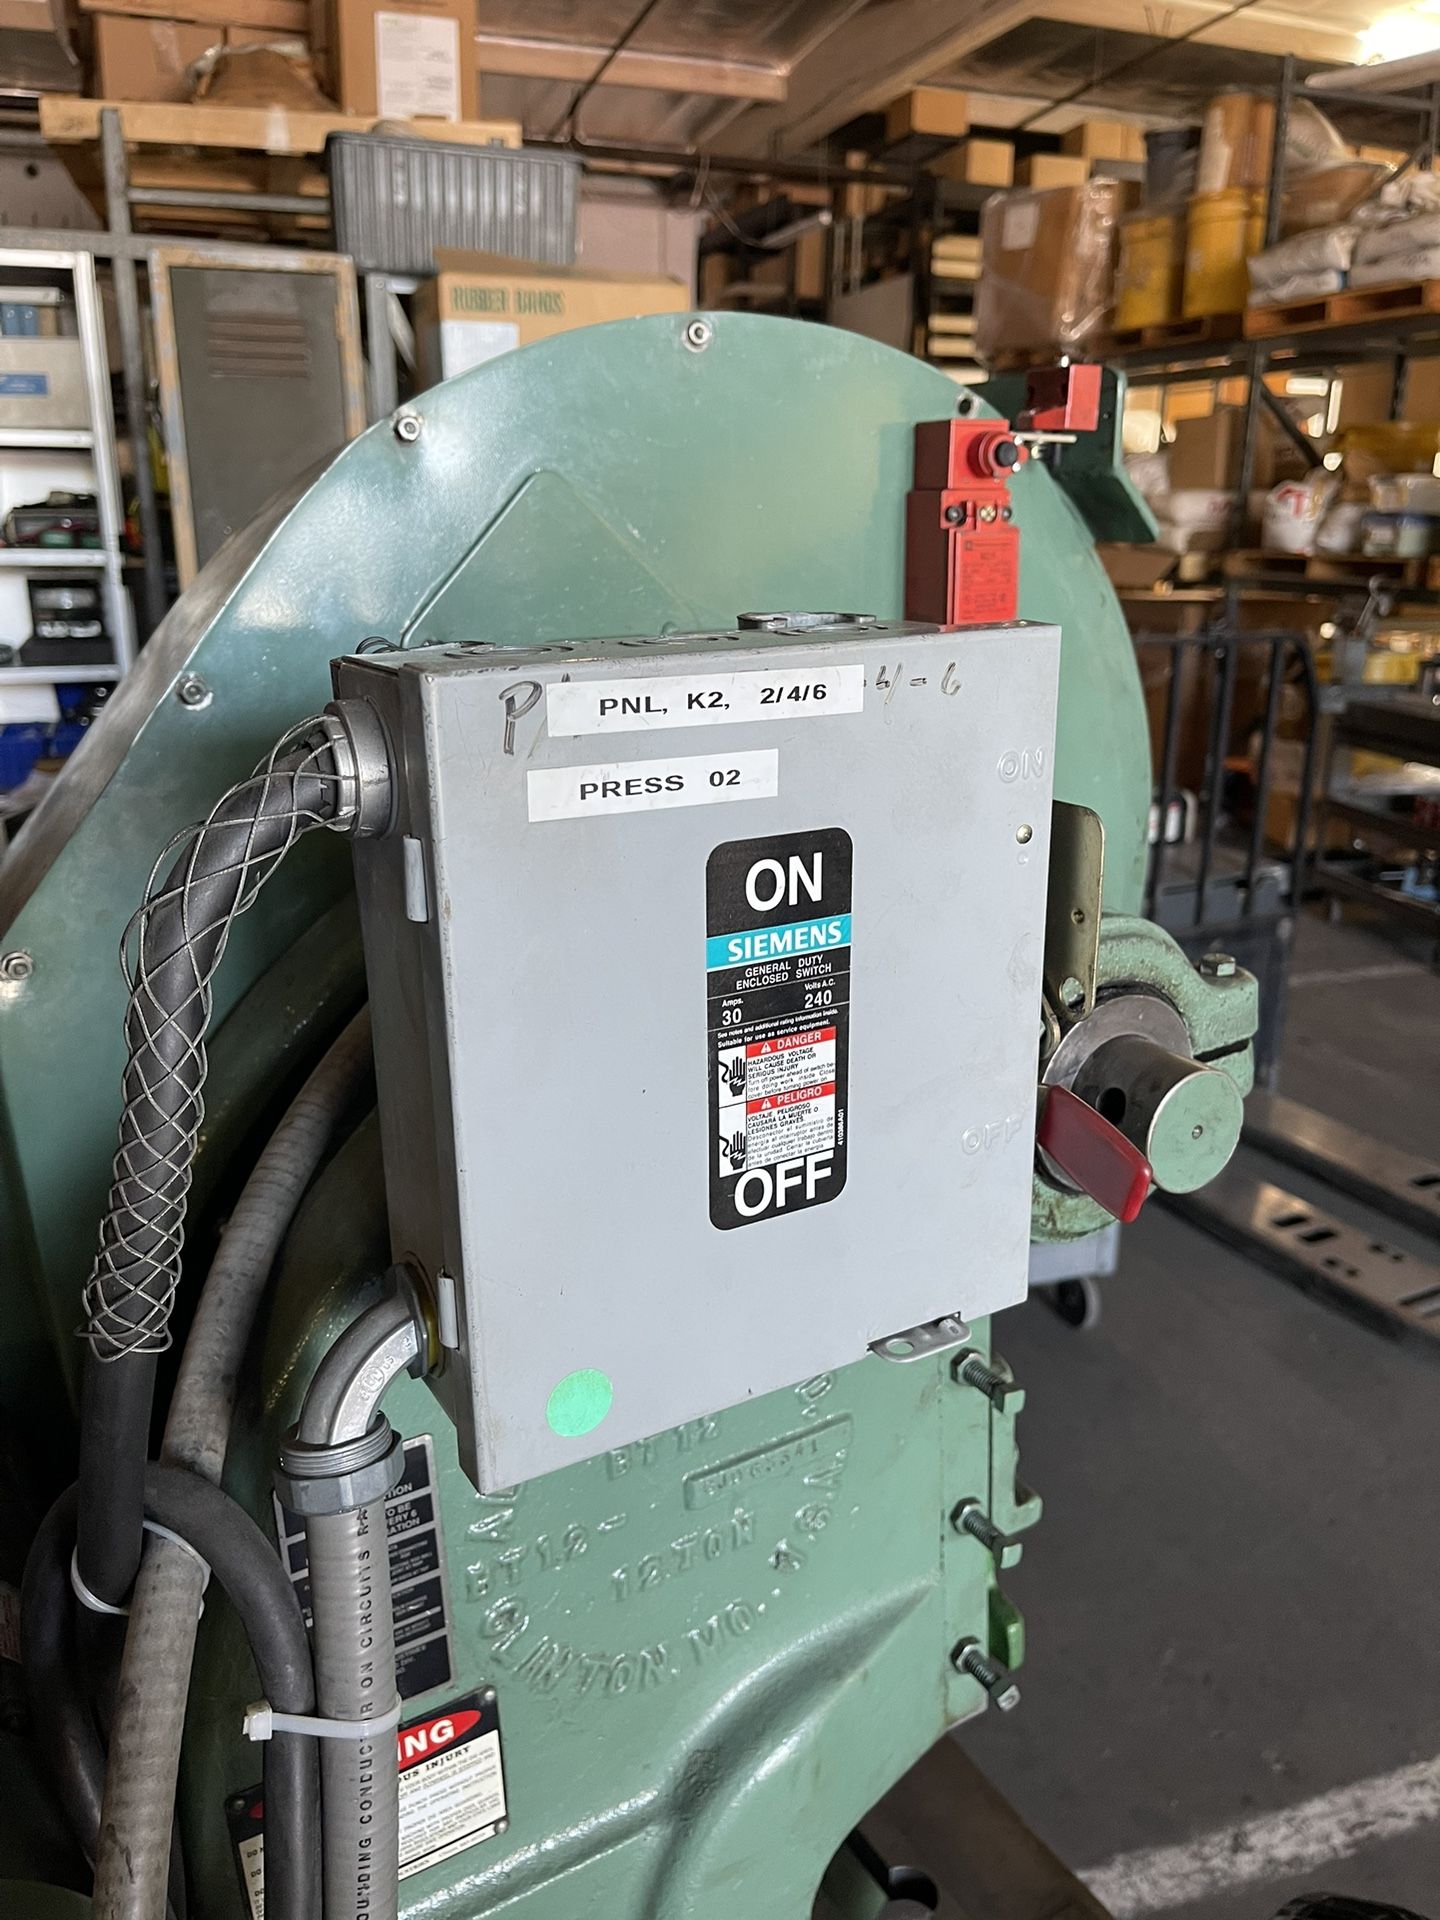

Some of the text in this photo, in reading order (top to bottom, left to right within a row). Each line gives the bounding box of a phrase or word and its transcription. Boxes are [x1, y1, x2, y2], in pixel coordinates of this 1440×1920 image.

[598, 682, 828, 718] PNL, K2, 2/4/6
[997, 747, 1044, 783] ON
[579, 768, 742, 801] PRESS 02
[745, 851, 823, 912] ON
[727, 920, 842, 962] SIEMENS
[736, 962, 832, 990] ENCLOSED SWITCH
[745, 954, 824, 978] GENERAL DUTY
[804, 981, 821, 991] Volts
[721, 998, 744, 1008] Amps.
[804, 989, 832, 1009] 240
[722, 1008, 742, 1026] 30
[718, 1019, 831, 1048] Suitable for use as service equipment.
[777, 1031, 822, 1050] DANGER
[748, 1046, 814, 1066] HAZARDOUS VOLTAGE
[748, 1052, 816, 1073] WILL CAUSE DEATH OR
[748, 1063, 799, 1080] SERIOUS INJURY
[777, 1087, 822, 1106] PELIGRO
[748, 1102, 810, 1122] VOLTAJE PELIGROSO
[788, 1108, 812, 1118] MUERTE
[748, 1123, 778, 1136] LESIONES
[734, 1148, 834, 1217] OFF
[396, 1502, 412, 1514] BE
[410, 1509, 418, 1518] 6
[358, 1549, 374, 1650] CIRCUITS
[360, 1660, 374, 1690] ON
[359, 1701, 374, 1826] CONDUCR
[426, 1745, 471, 1770] INJURY
